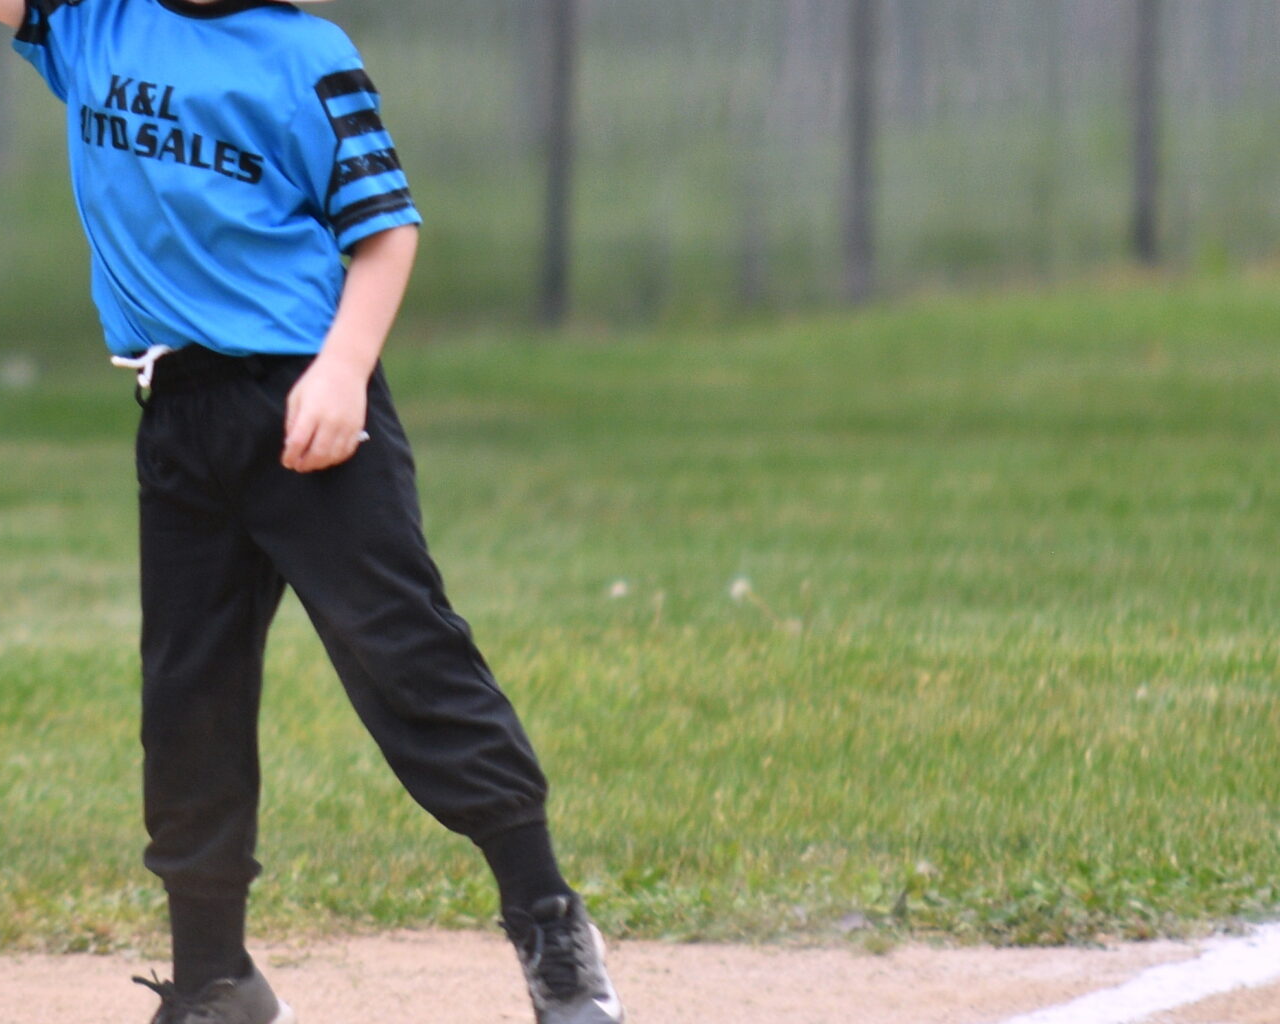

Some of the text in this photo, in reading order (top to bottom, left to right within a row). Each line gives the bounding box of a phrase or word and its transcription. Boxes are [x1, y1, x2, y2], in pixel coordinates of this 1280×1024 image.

[104, 74, 179, 122] K&L
[80, 104, 265, 185] UTO SALES
